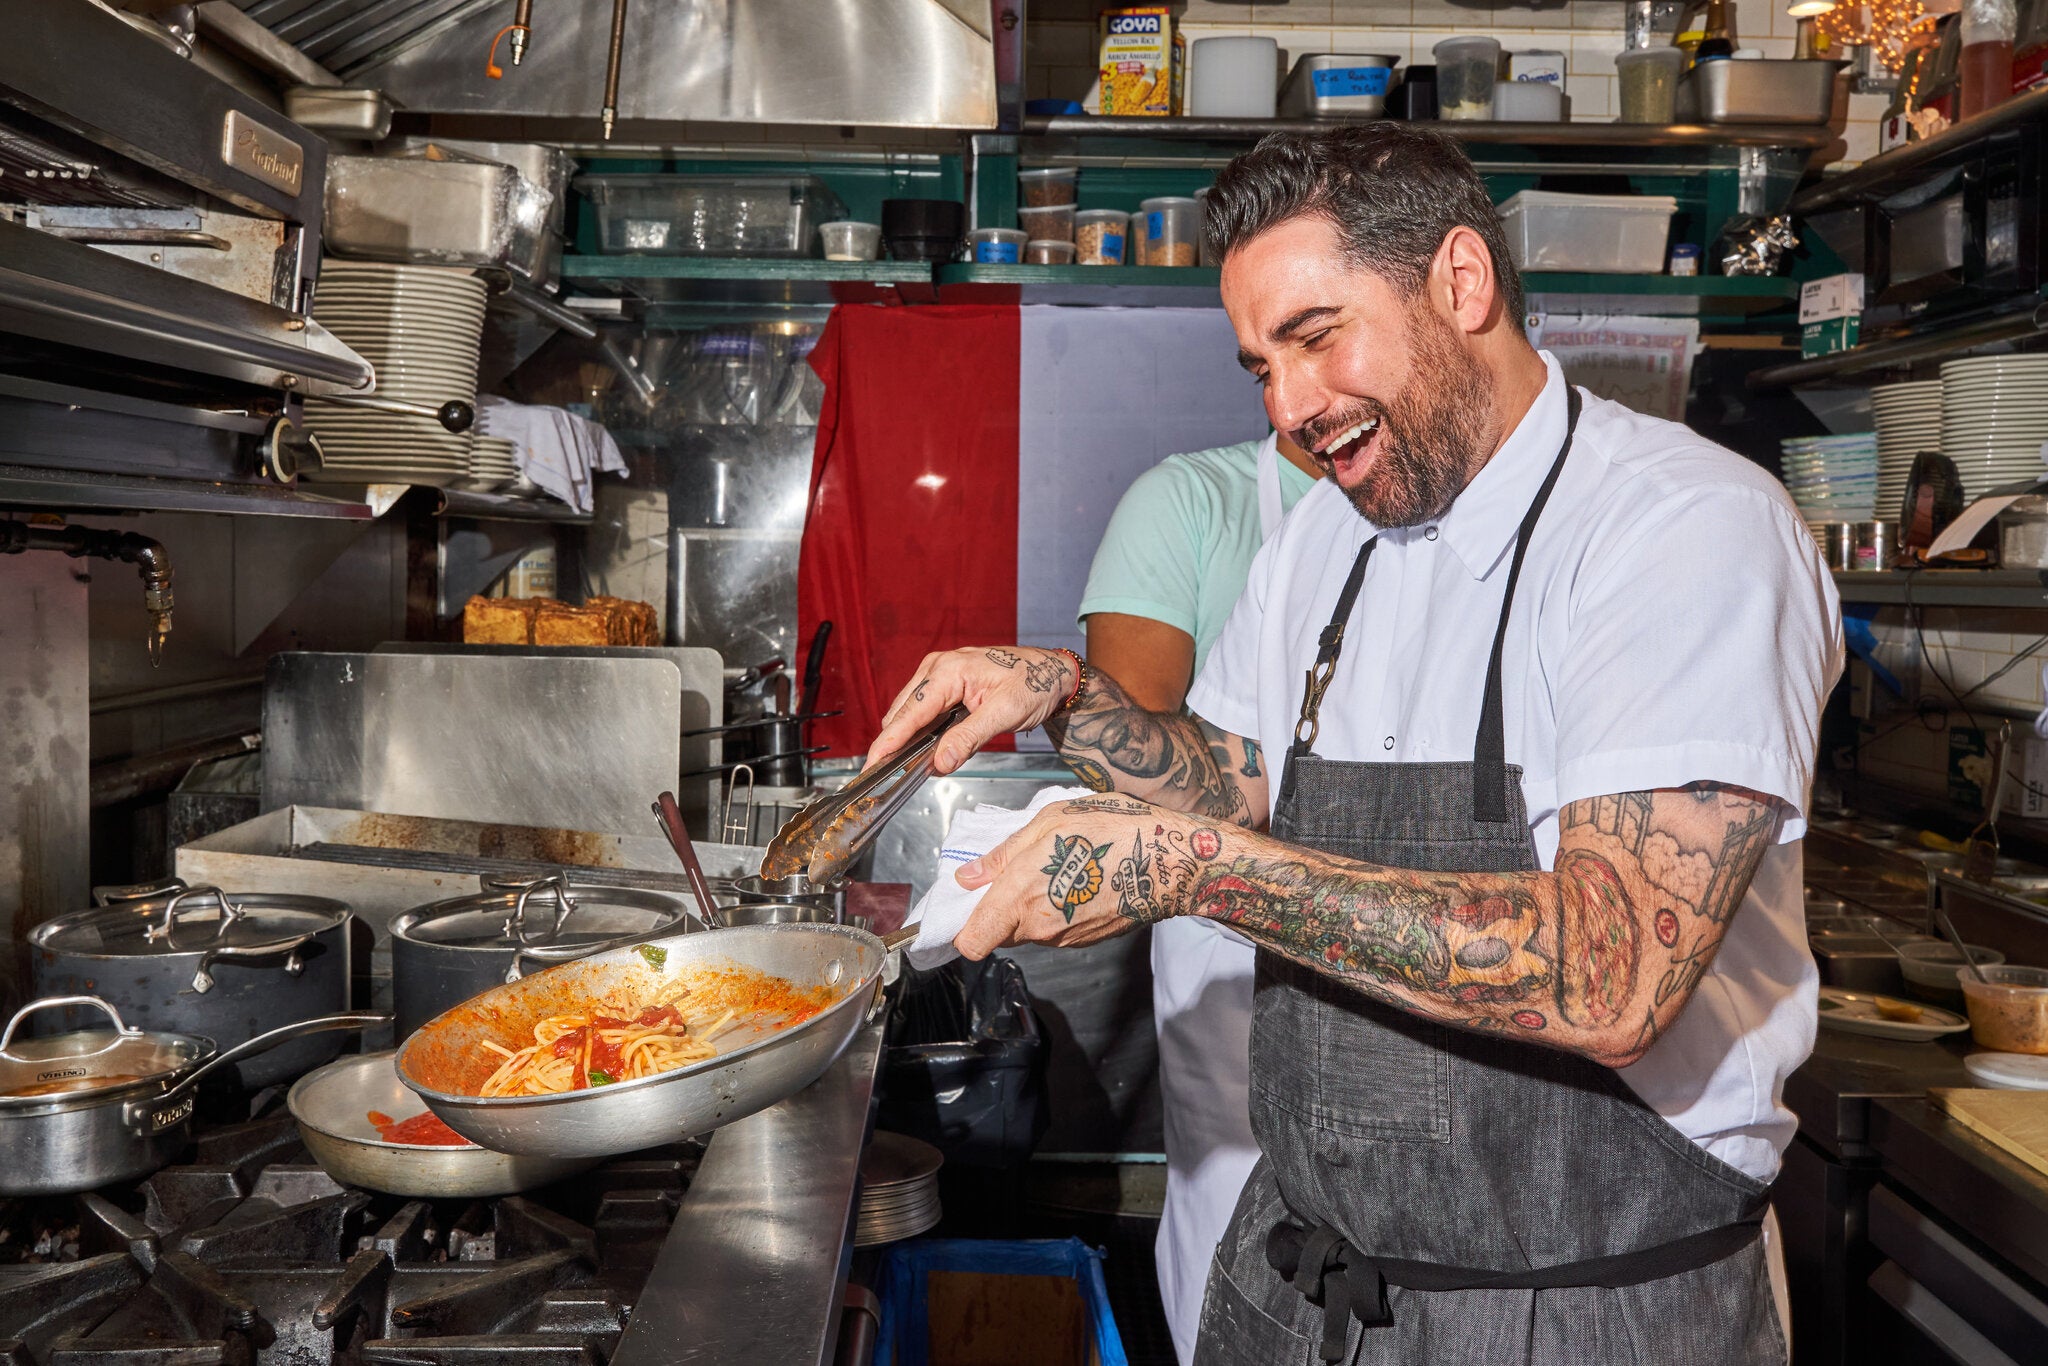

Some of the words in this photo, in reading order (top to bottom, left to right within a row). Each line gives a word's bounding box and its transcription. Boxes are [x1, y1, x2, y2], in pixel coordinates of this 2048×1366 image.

[1110, 17, 1159, 33] GOYA
[1804, 283, 1822, 294] LATEX
[1804, 324, 1822, 335] LATEX
[1053, 844, 1089, 899] FIGLIA
[1123, 861, 1136, 900] TRUE
[1135, 902, 1152, 920] LOV
[41, 1070, 83, 1080] VIKING
[153, 1100, 193, 1127] VIKING
